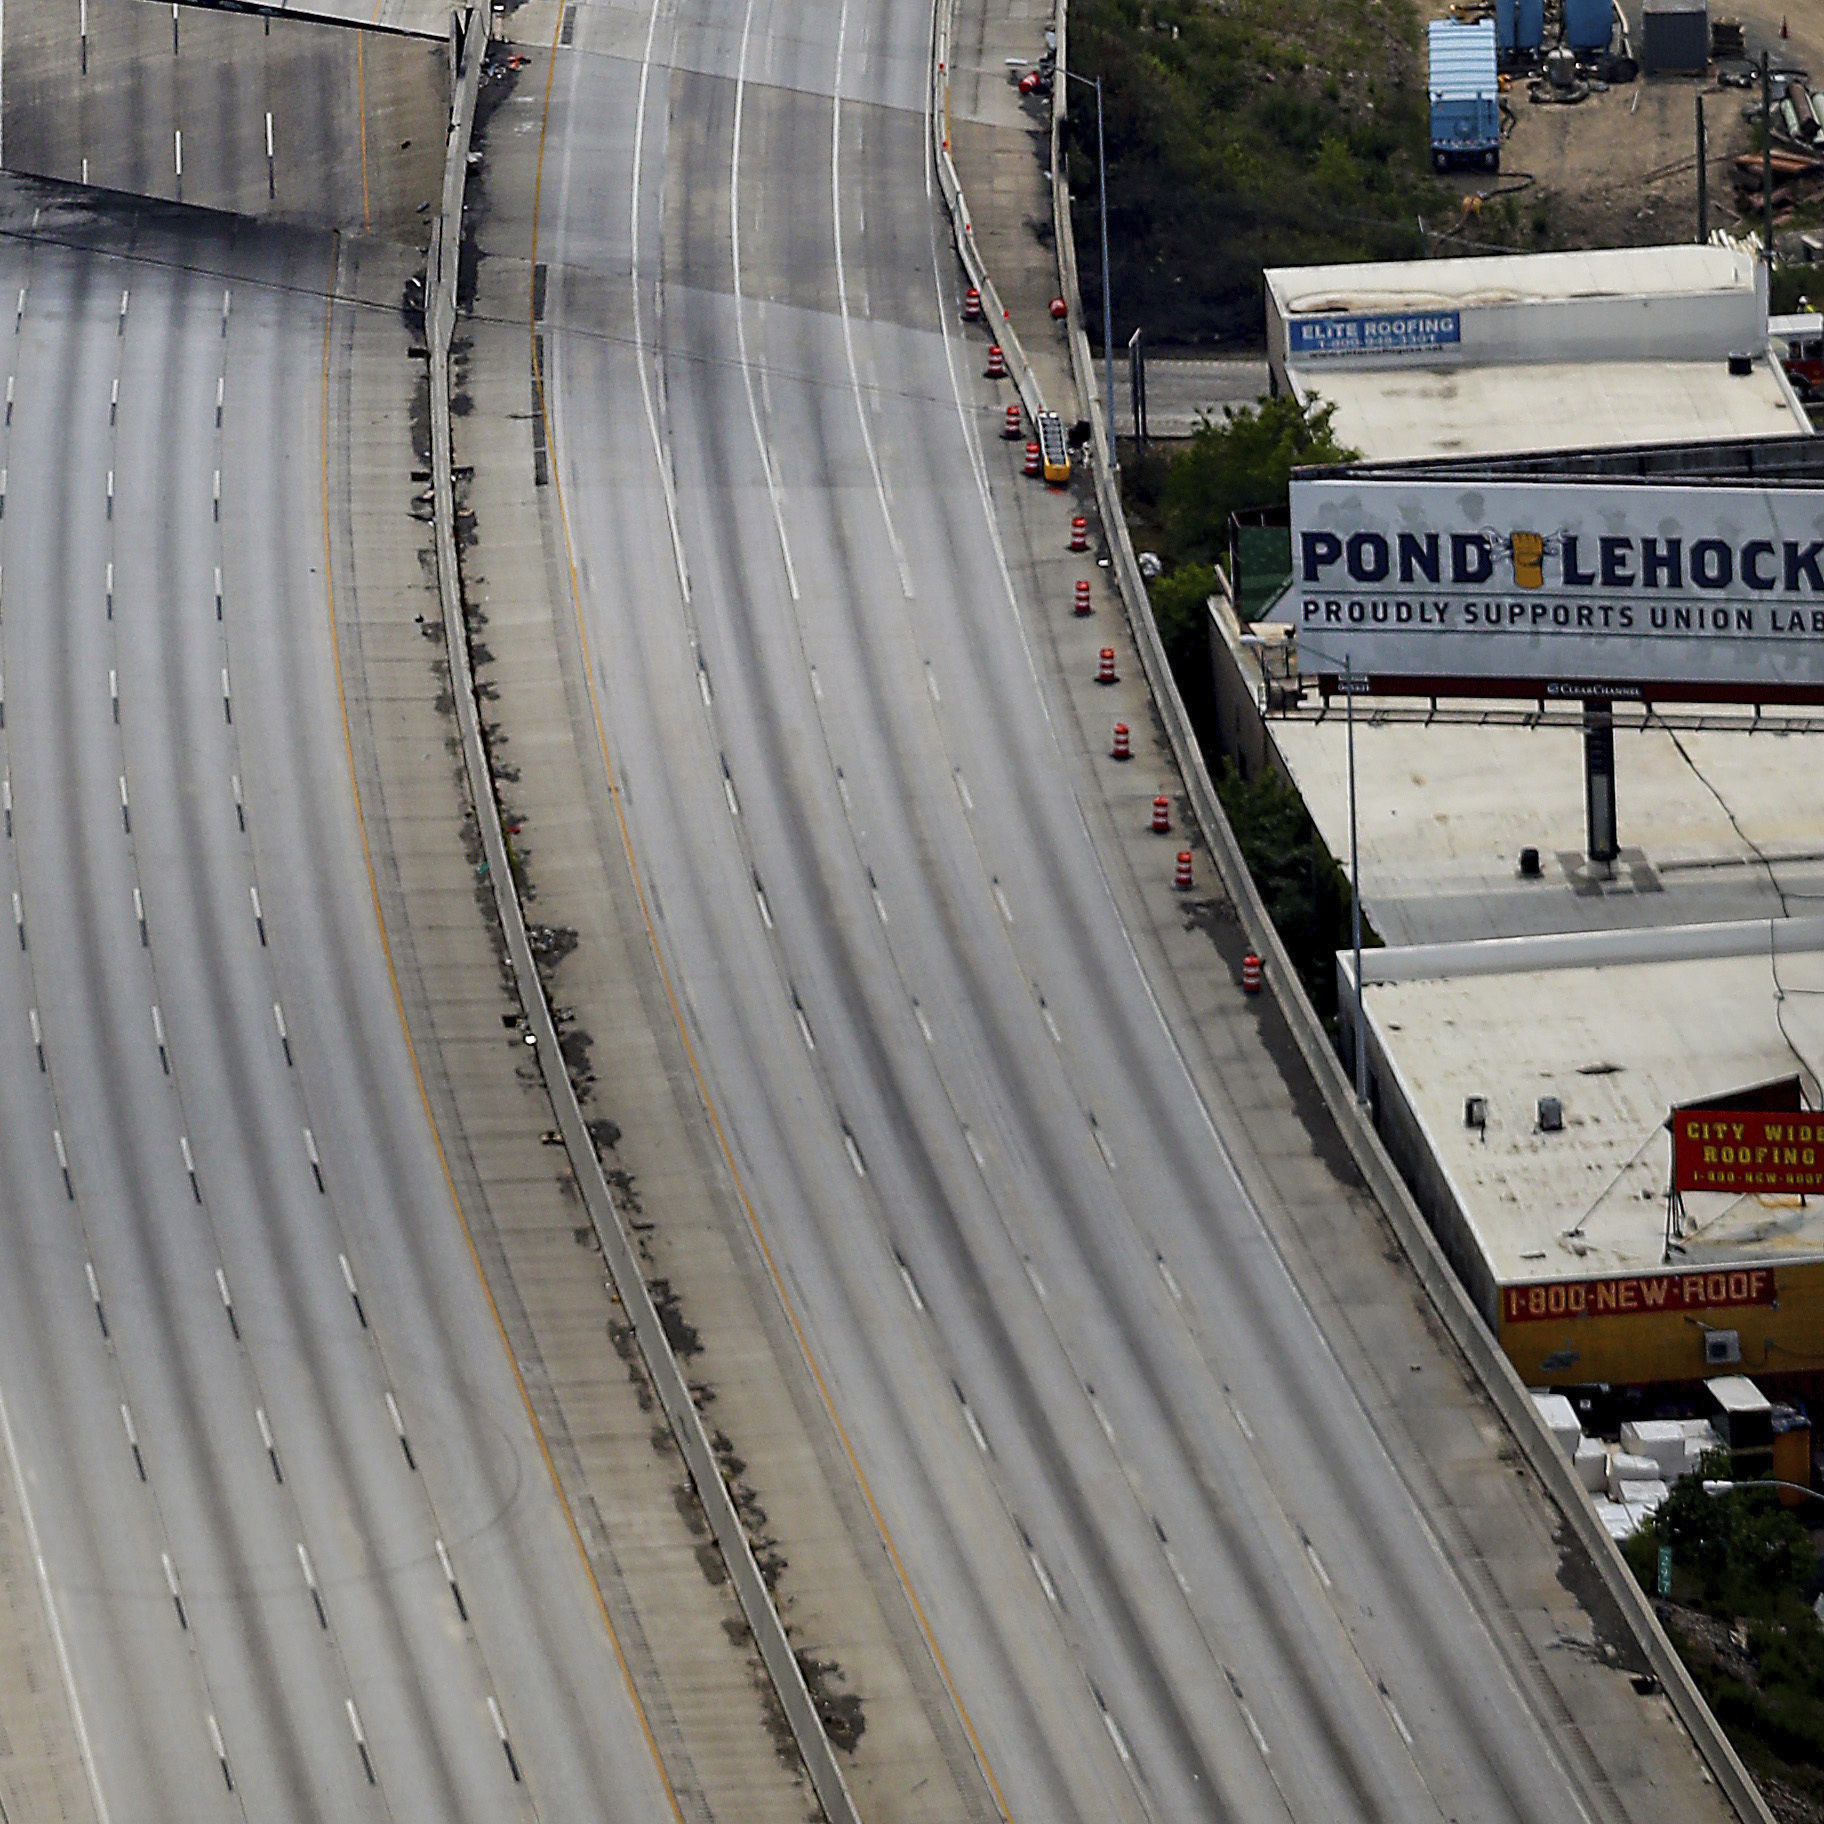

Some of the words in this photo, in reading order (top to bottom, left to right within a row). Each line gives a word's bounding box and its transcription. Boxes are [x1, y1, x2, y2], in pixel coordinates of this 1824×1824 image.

[1364, 317, 1455, 336] ROOFING
[1300, 531, 1494, 583] POND
[1303, 601, 1448, 622] PROUDLY
[1464, 603, 1634, 627] SUPPORTS
[1650, 607, 1754, 630] UNION
[1687, 1122, 1745, 1140] CITY
[1703, 1146, 1815, 1165] ROOFING
[1508, 1271, 1768, 1317] 1-800-NEW-ROOF
